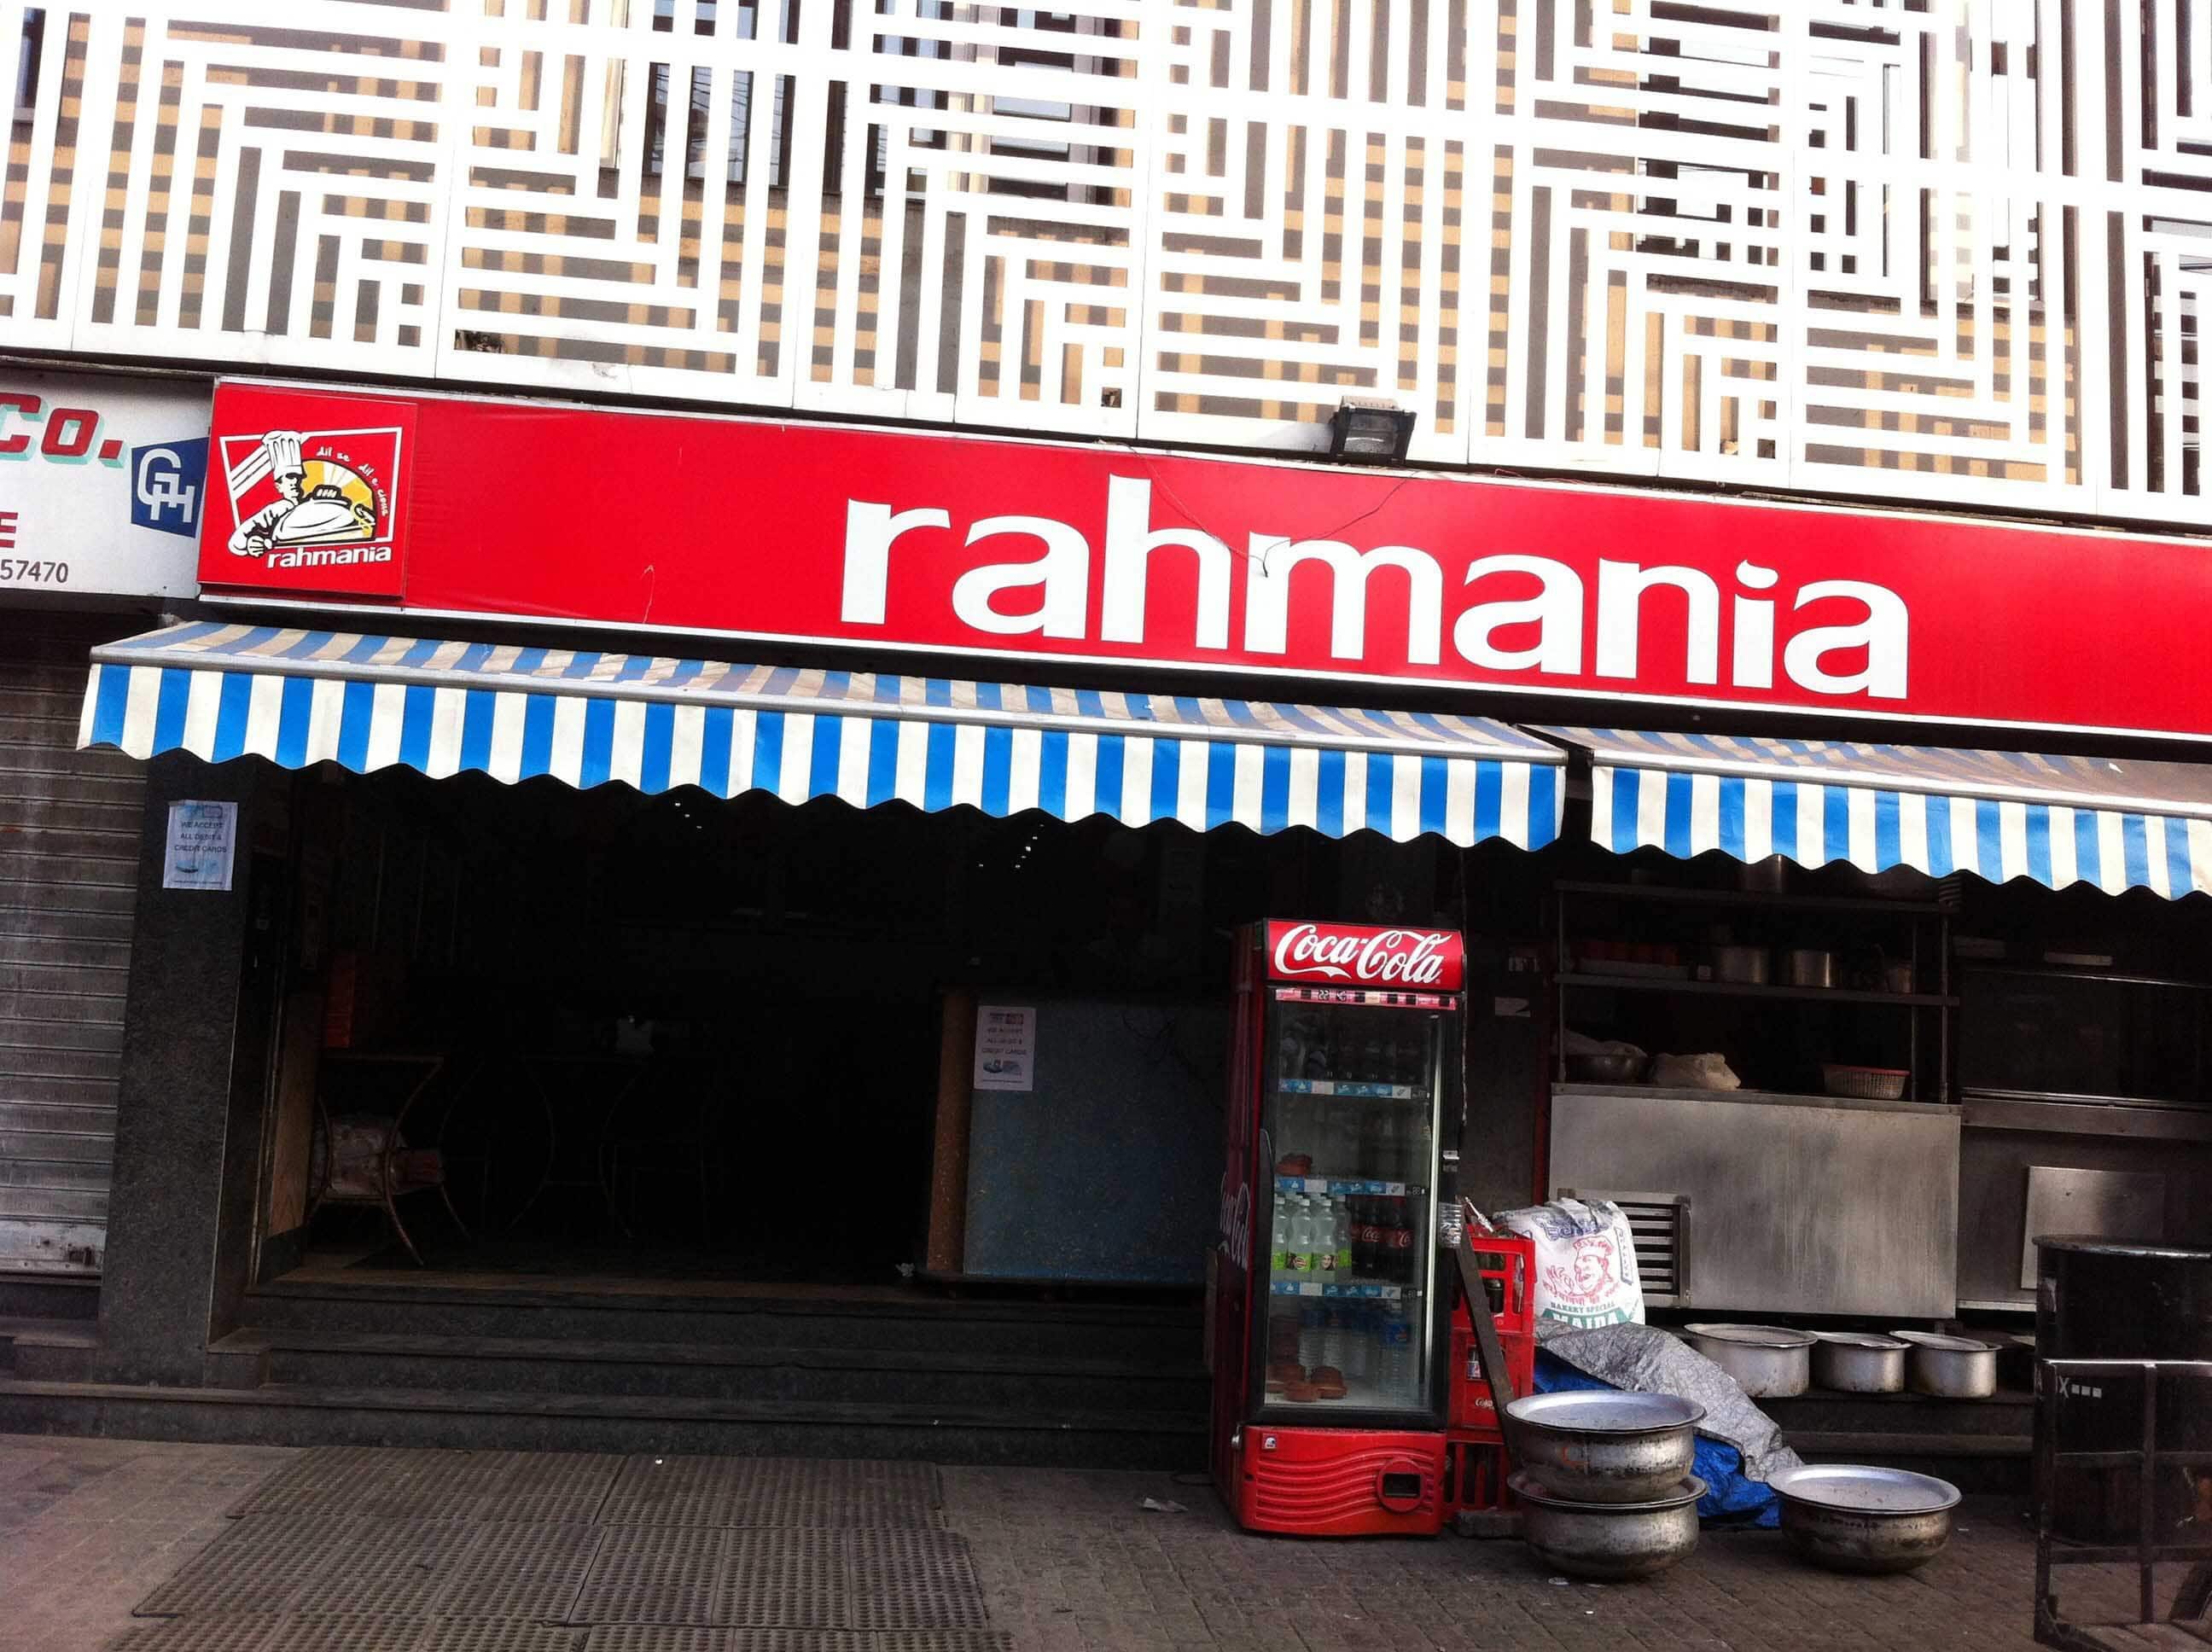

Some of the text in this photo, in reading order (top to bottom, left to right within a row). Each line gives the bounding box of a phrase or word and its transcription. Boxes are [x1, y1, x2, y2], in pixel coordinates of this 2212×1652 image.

[267, 544, 392, 568] rahmania
[840, 474, 1910, 700] rahmania
[201, 846, 228, 854] CARDS
[1274, 922, 1452, 984] Coca-Cola
[1550, 1301, 1615, 1313] BAKERY SPECIAL
